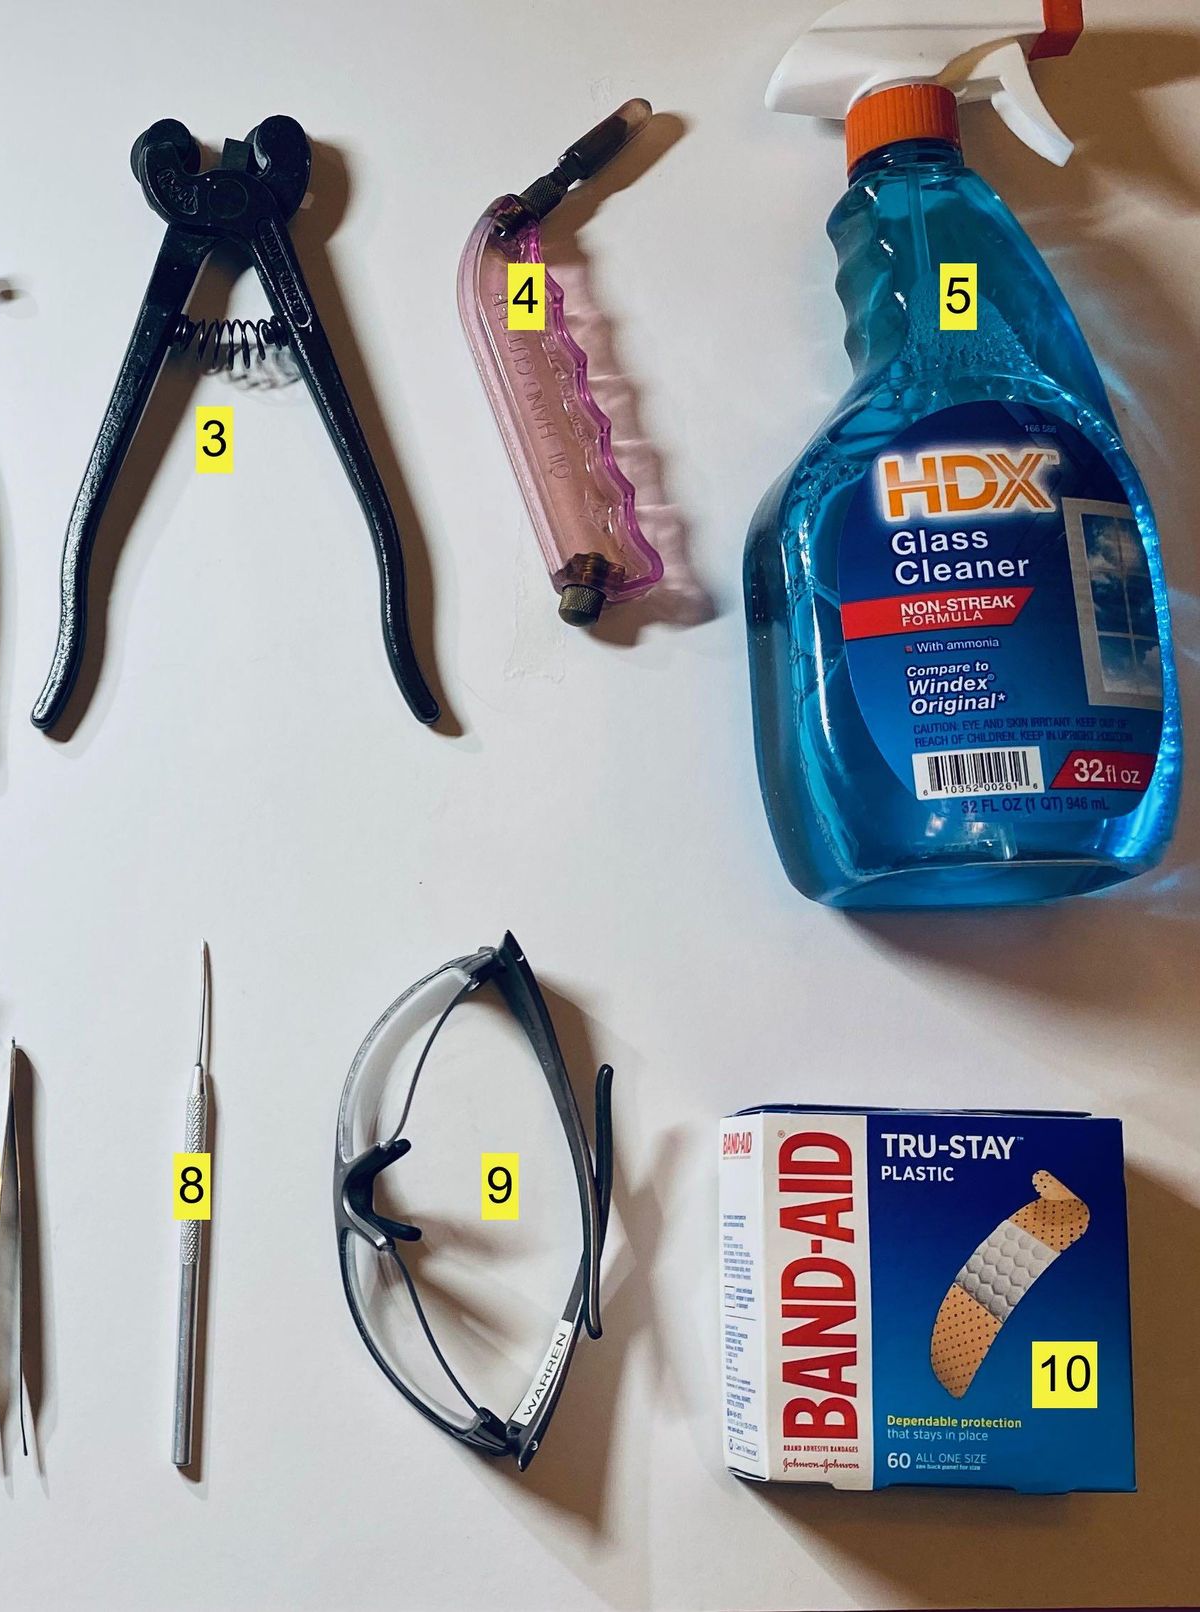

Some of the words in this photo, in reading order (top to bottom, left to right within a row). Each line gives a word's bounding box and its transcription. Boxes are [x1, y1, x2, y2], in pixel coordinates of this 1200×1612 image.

[884, 453, 1052, 517] HDX
[891, 529, 989, 556] Glass
[895, 558, 1030, 586] Cleaner
[900, 594, 1016, 616] NON-STREAK
[902, 610, 983, 627] FORMULA
[916, 641, 944, 653] With
[946, 638, 1000, 651] ammonia
[906, 663, 971, 677] Compare
[975, 661, 989, 672] to
[962, 719, 981, 731] EYE
[983, 718, 1004, 729] AND
[1006, 717, 1028, 728] SKIN
[914, 735, 949, 748] REACH
[951, 733, 964, 745] OF
[1020, 730, 1044, 741] KEEP
[1120, 769, 1142, 784] oz
[922, 789, 929, 797] 6
[944, 783, 979, 794] 10352
[984, 782, 1018, 792] 00261
[1033, 782, 1039, 790] 6
[961, 800, 978, 814] 32
[982, 798, 999, 812] FL
[1002, 797, 1023, 812] OZ
[1041, 796, 1063, 813] QT)
[1066, 796, 1088, 811] 946
[1091, 797, 1110, 810] mL
[723, 1131, 753, 1156] BAND-AID
[881, 1165, 955, 1182] PLASTIC
[779, 1131, 859, 1440] BAND-AID
[523, 1332, 567, 1416] WARREN
[887, 1415, 958, 1428] Dependable
[961, 1417, 1022, 1429] protection
[887, 1428, 910, 1439] that
[912, 1429, 942, 1442] stays
[945, 1430, 956, 1440] in
[958, 1430, 989, 1443] place
[803, 1445, 829, 1453] ADHESIVE
[830, 1445, 859, 1453] BANDAGES
[887, 1451, 912, 1469] 60
[915, 1452, 936, 1463] ALL
[938, 1453, 962, 1464] ONE
[964, 1453, 988, 1464] SIZE
